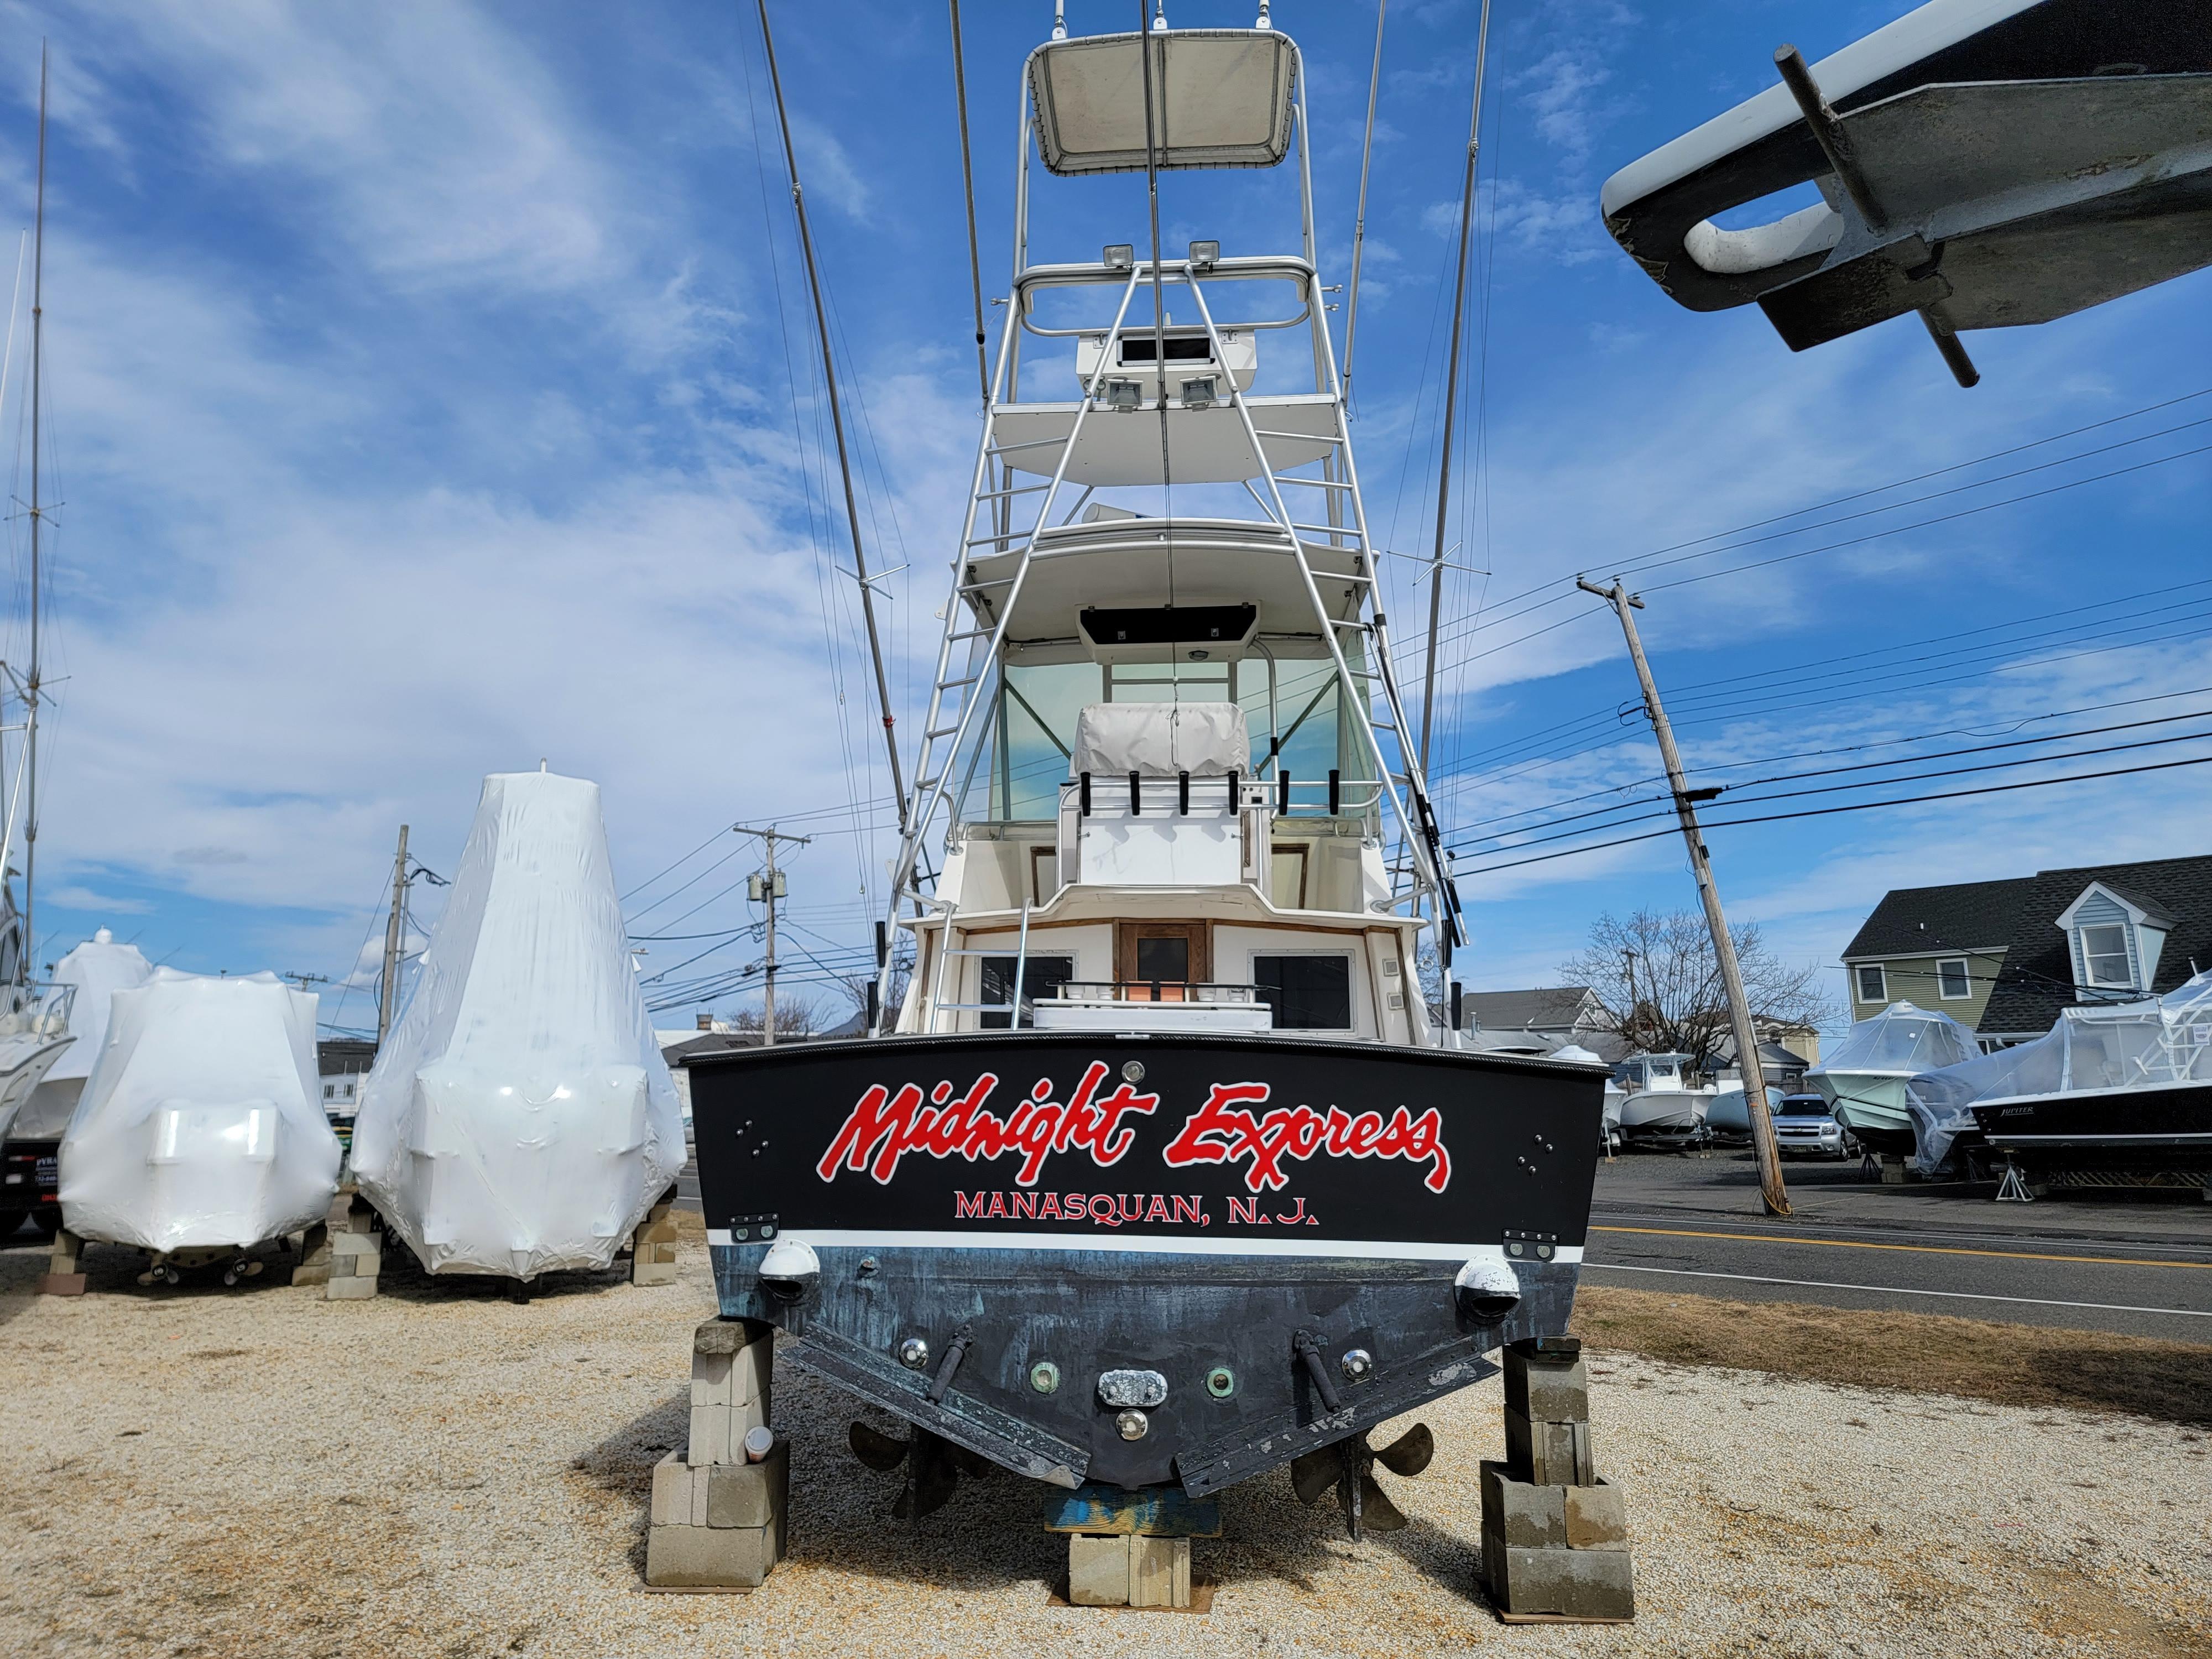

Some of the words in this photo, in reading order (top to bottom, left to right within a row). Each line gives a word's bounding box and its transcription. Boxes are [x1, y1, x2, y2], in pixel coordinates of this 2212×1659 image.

[816, 1061, 1160, 1185] Midnight
[1162, 1082, 1451, 1193] Express
[2000, 1107, 2033, 1117] JUPITER
[954, 1191, 1210, 1227] MANASQUAN,
